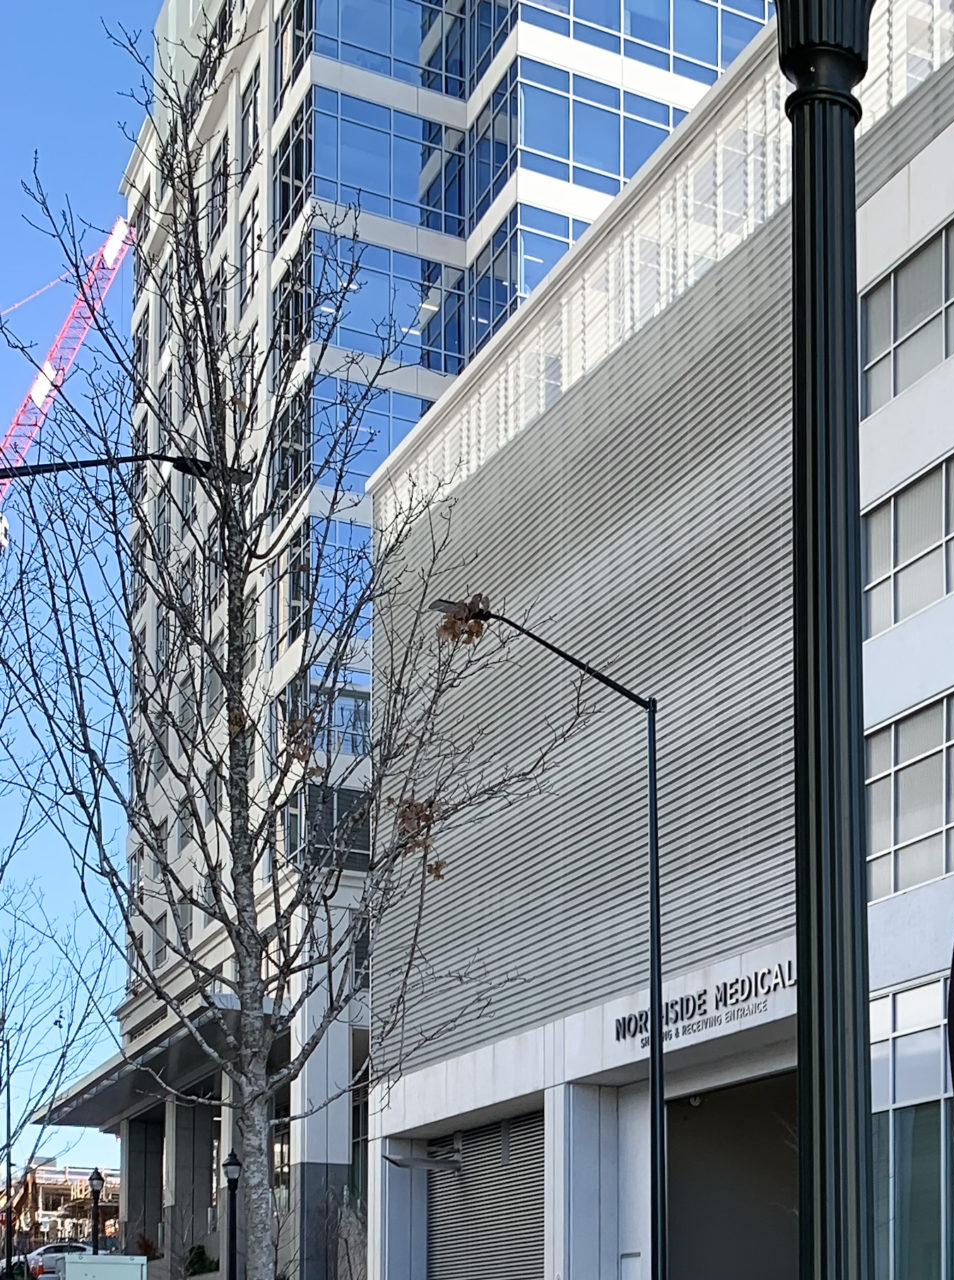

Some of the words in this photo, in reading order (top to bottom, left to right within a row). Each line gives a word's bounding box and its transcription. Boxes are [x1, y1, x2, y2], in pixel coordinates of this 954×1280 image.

[615, 989, 708, 1042] NORHSIDE
[715, 960, 798, 1011] MEDICAL
[640, 1029, 673, 1049] SHNG
[675, 1027, 680, 1039] &
[682, 1014, 723, 1036] RECEIVING
[725, 999, 768, 1024] ENTRANCE
